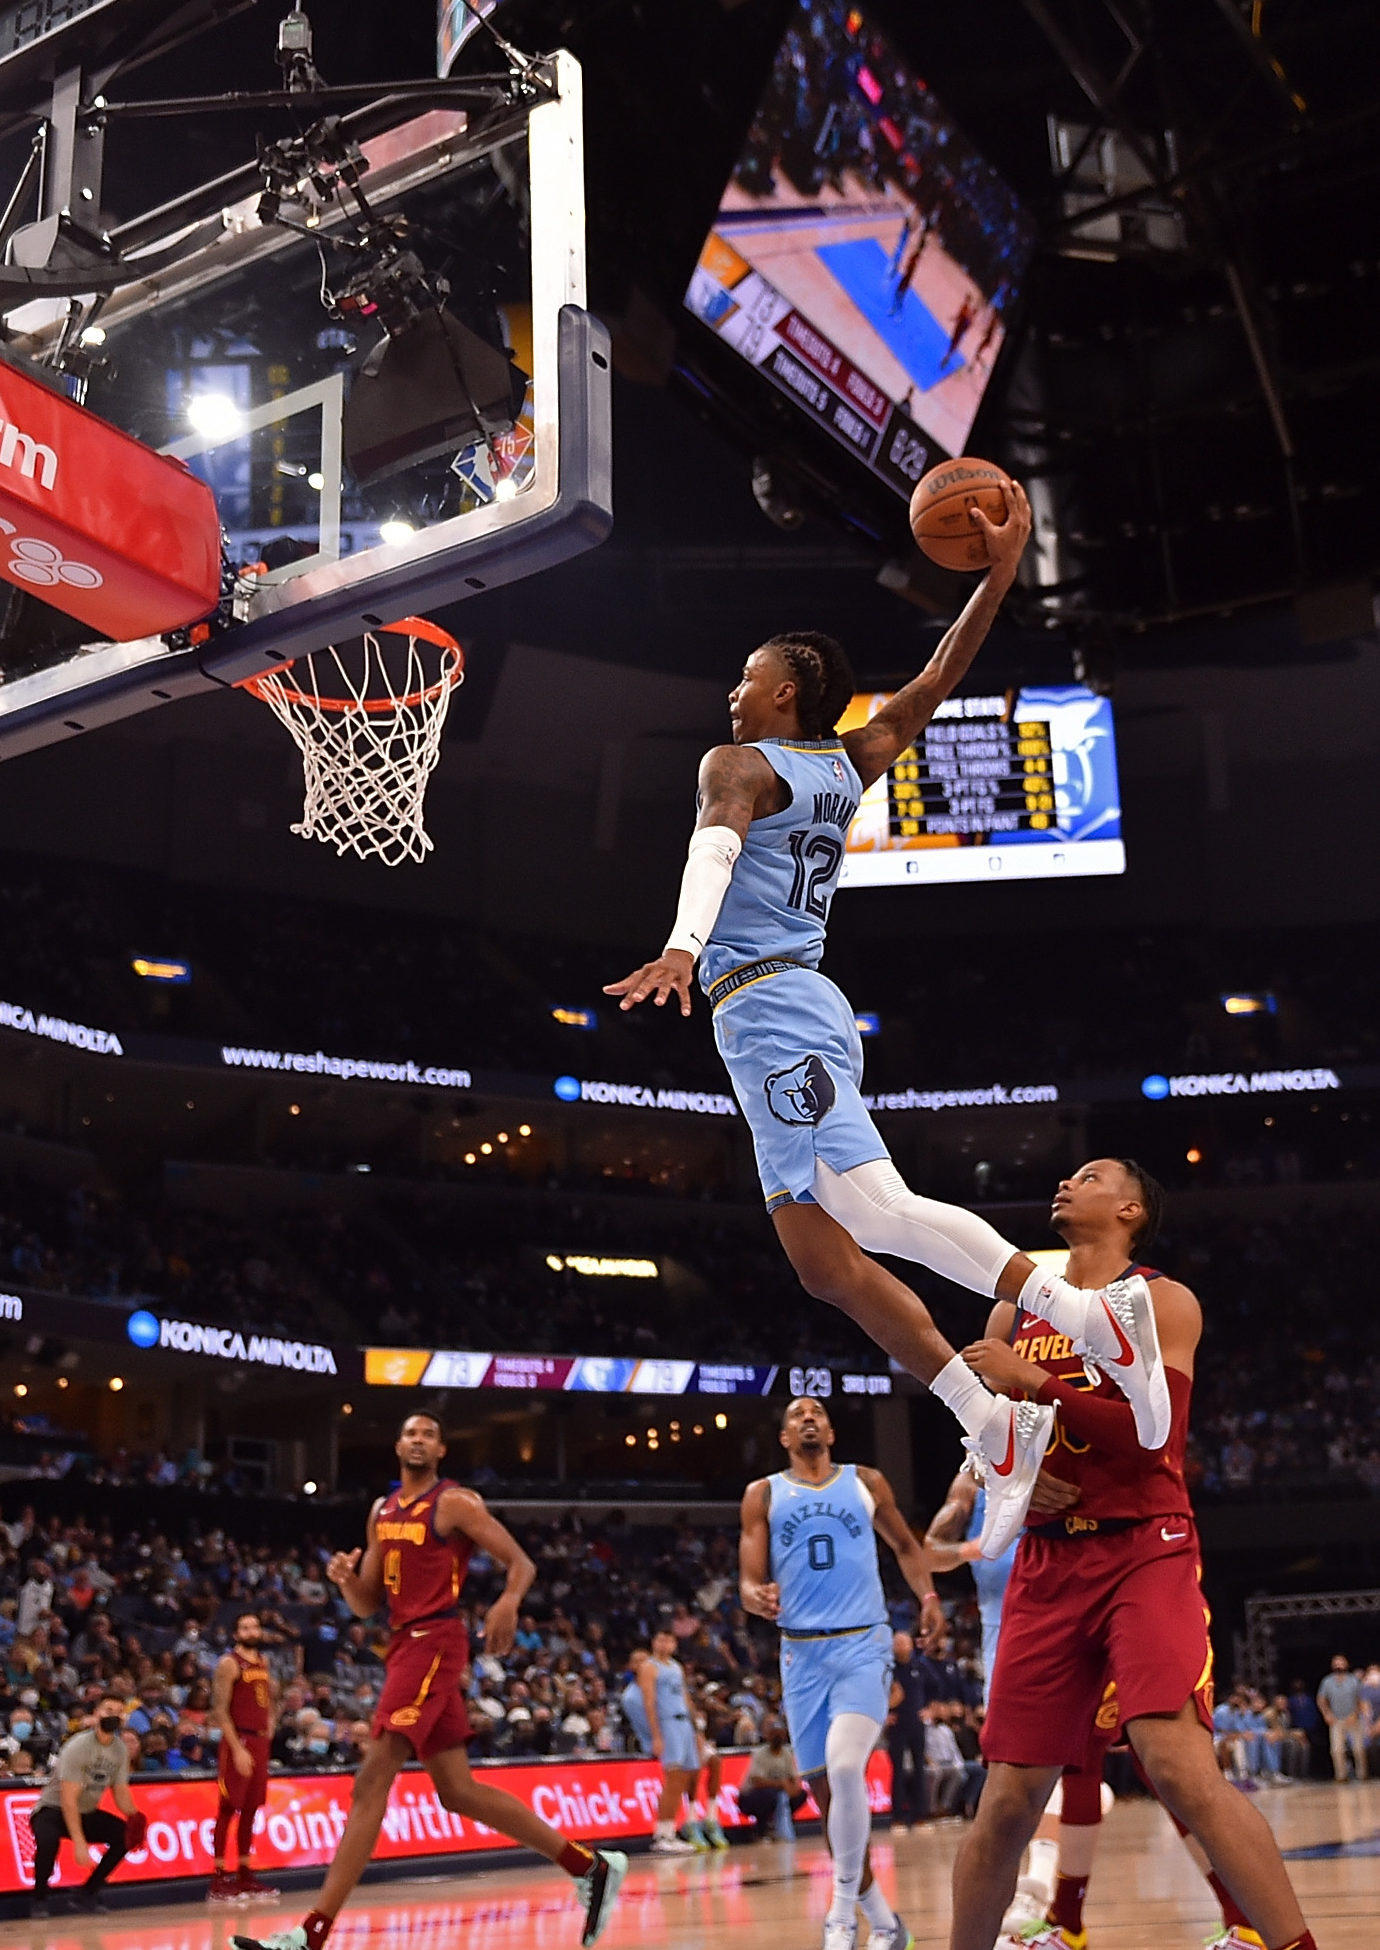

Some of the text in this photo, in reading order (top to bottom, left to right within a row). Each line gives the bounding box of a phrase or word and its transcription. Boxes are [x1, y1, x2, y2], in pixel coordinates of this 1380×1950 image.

[0, 419, 58, 491] m
[787, 830, 842, 922] 12
[37, 1015, 124, 1056] MINOLTA
[222, 1046, 471, 1088] www.reshapework.com
[1169, 1068, 1341, 1097] KONICA MINOLTA
[581, 1080, 739, 1115] KONICA MINOLTA
[862, 1086, 1058, 1111] w.reshapework.com
[160, 1318, 338, 1375] KONICA MINOLTA
[1013, 1334, 1075, 1363] CLEVEL
[780, 1502, 862, 1547] GRIZZLIES
[808, 1534, 835, 1571] 0
[381, 1791, 464, 1842] with
